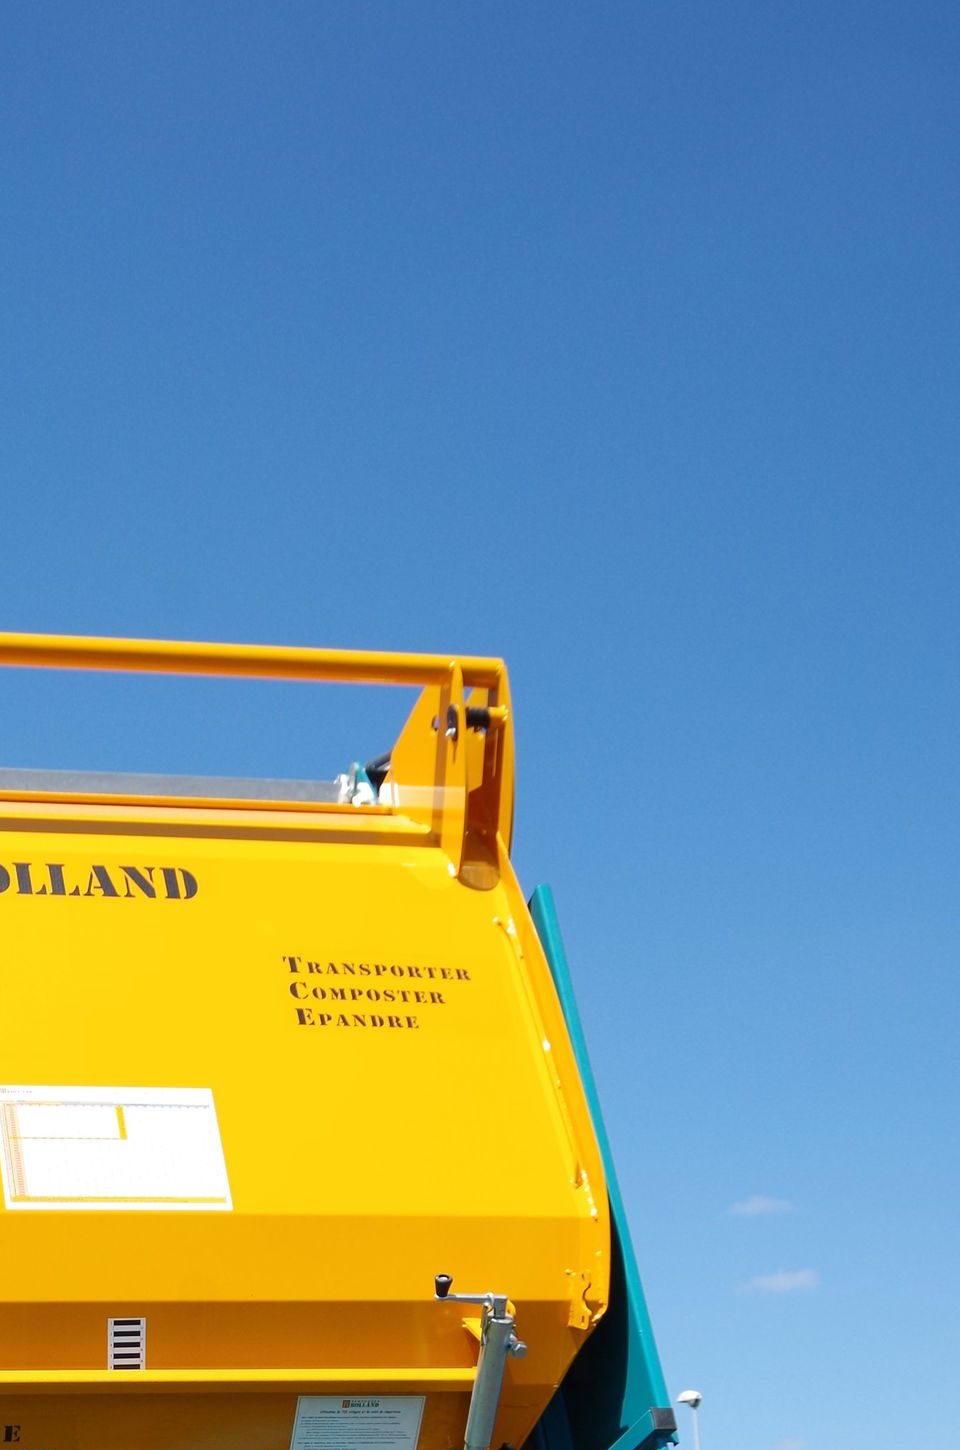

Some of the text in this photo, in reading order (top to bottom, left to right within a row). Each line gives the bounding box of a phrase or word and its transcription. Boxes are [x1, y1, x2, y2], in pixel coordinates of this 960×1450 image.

[282, 956, 472, 981] TRANSPORTER
[289, 982, 446, 1005] COMPOSTER
[295, 1007, 420, 1030] EPANDRE
